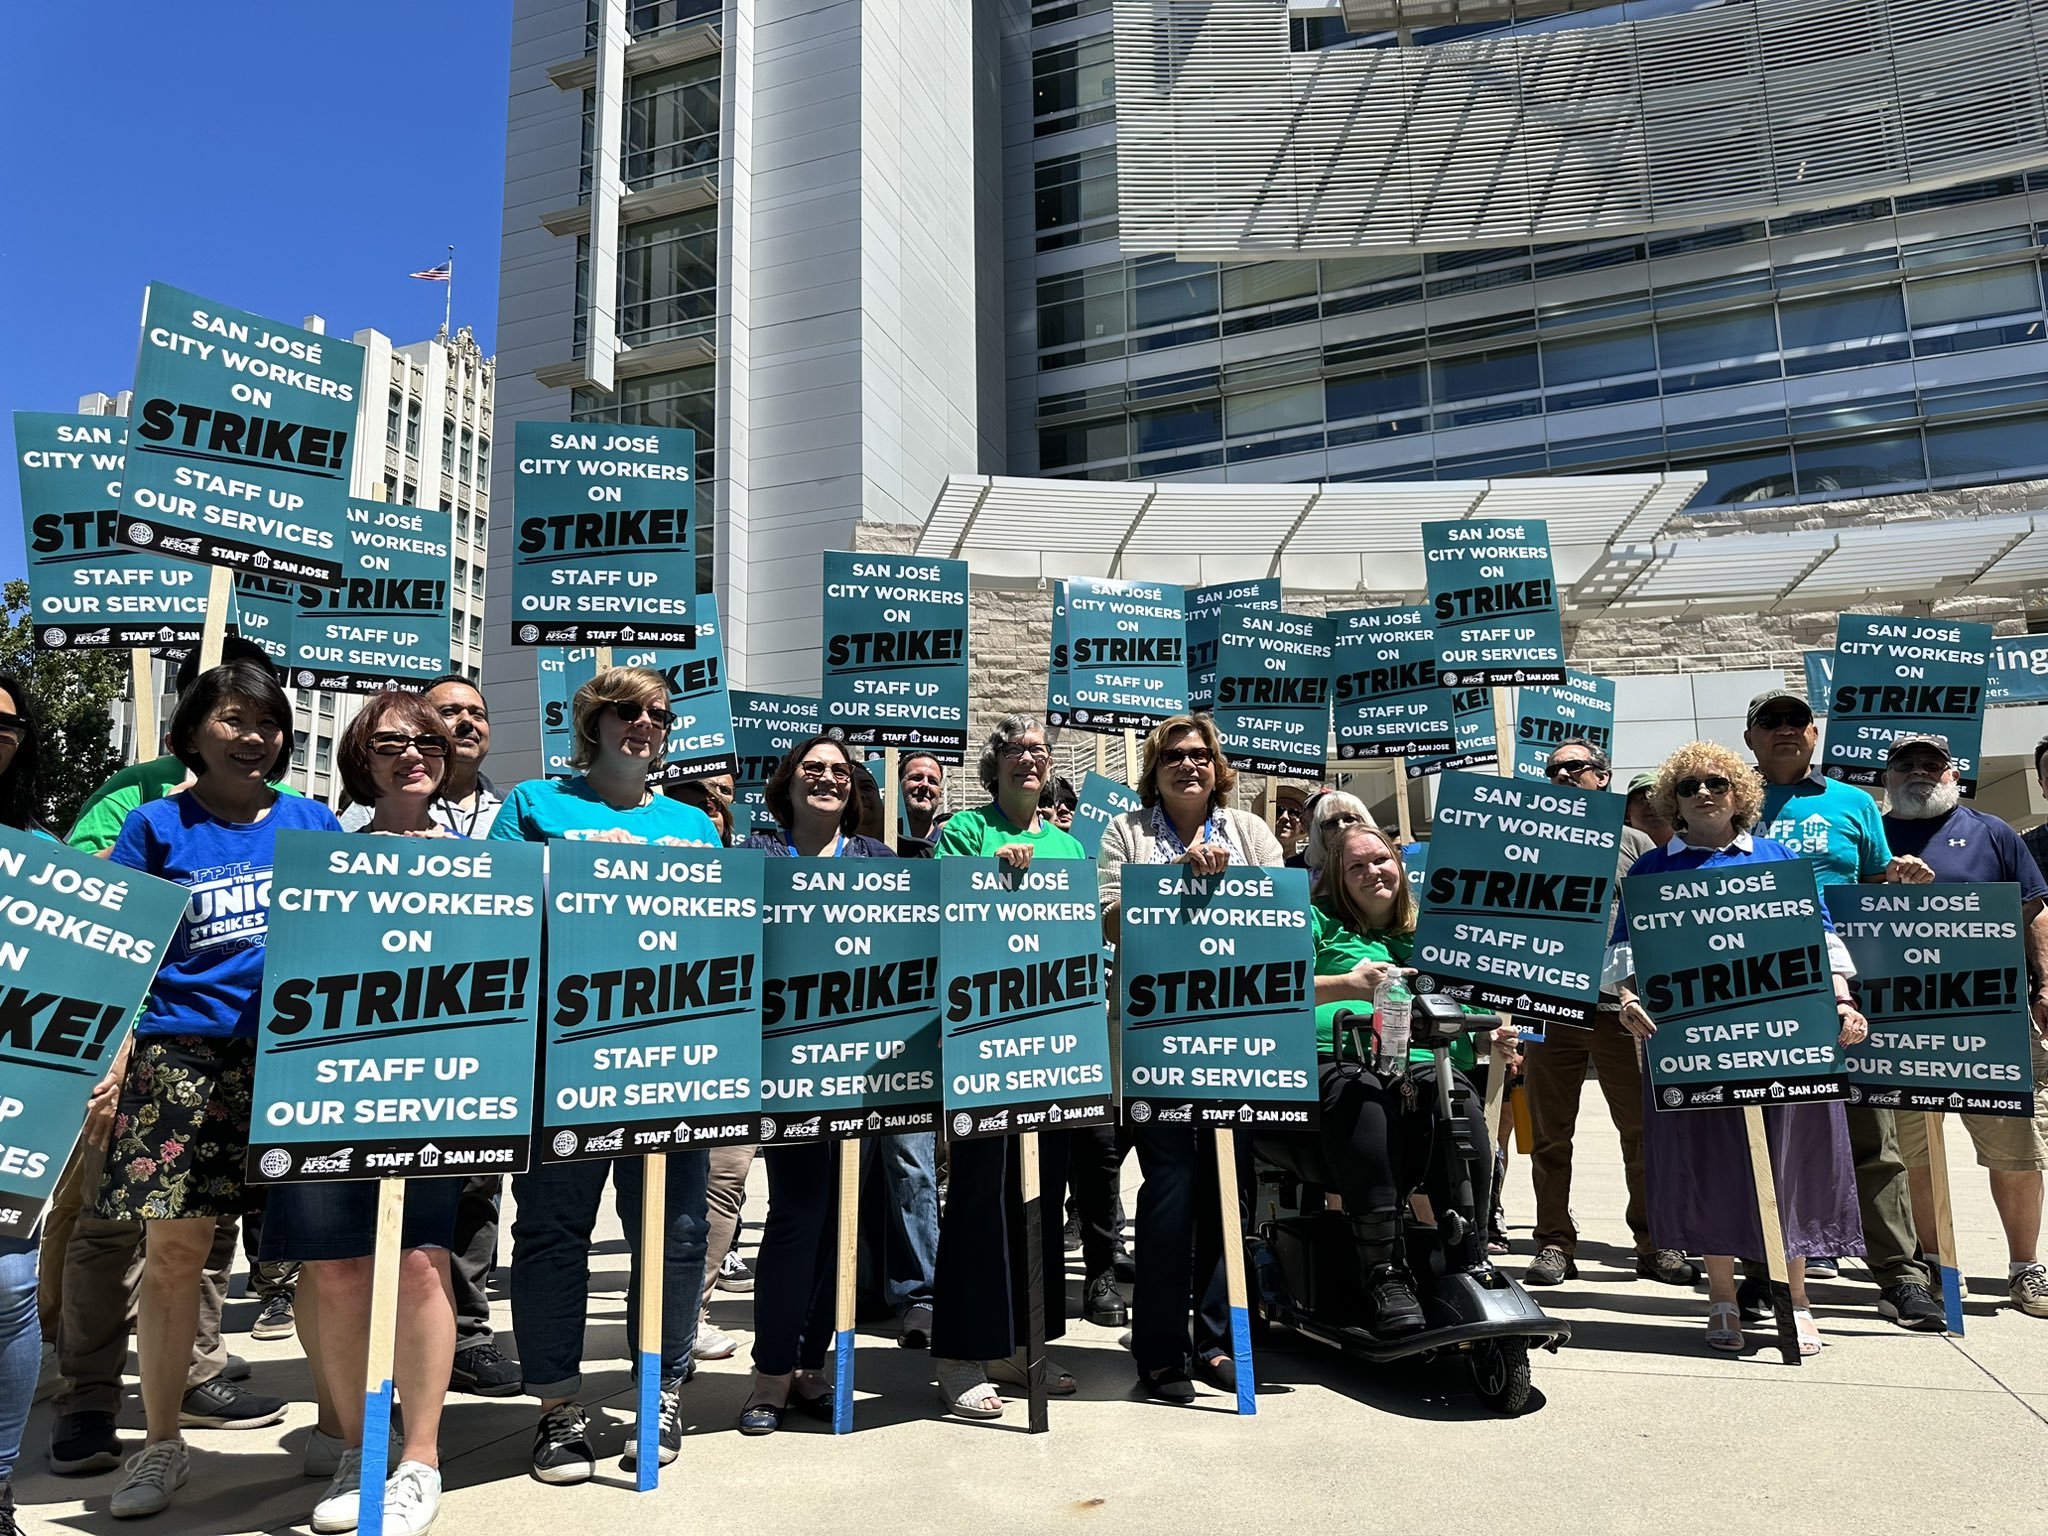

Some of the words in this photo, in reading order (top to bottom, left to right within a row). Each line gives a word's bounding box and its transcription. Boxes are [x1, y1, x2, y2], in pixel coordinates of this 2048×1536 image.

[191, 310, 249, 343] SAN
[254, 331, 322, 365] JOSÉ
[150, 327, 215, 361] CITY
[221, 348, 353, 402] WORKERS
[231, 383, 272, 409] ON
[138, 398, 347, 469] STRIKE!
[550, 434, 596, 450] SAN
[602, 435, 659, 454] JOSÉ
[519, 458, 571, 475] CITY
[576, 460, 689, 482] WORKERS
[174, 466, 262, 501] STAFF
[268, 489, 304, 512] UP
[587, 485, 622, 502] ON
[134, 488, 197, 519] OUR
[202, 505, 334, 549] SERVICES
[373, 512, 423, 532] JOSÉ
[518, 508, 689, 553] STRIKE!
[1448, 527, 1483, 541] SAN
[1486, 525, 1526, 540] JOSÉ
[350, 530, 447, 557] WORKERS
[1427, 548, 1464, 562] CITY
[1469, 546, 1548, 559] WORKERS
[360, 554, 390, 571] ON
[852, 563, 891, 578] SAN
[895, 565, 941, 582] JOSÉ
[1479, 565, 1504, 578] ON
[551, 569, 622, 586] STAFF
[627, 571, 658, 587] UP
[521, 595, 571, 611] OUR
[577, 595, 687, 615] SERVICES
[827, 584, 870, 599] CITY
[874, 586, 964, 605] WORKERS
[1434, 579, 1552, 620] STRIKE!
[883, 608, 911, 623] ON
[1072, 598, 1106, 612] CITY
[1109, 601, 1182, 620] WORKERS
[326, 624, 388, 643] STAFF
[393, 631, 419, 644] UP
[1116, 620, 1139, 633] ON
[1242, 616, 1273, 632] SAN
[1275, 621, 1313, 637] JOSÉ
[1460, 628, 1511, 642] STAFF
[1514, 628, 1536, 641] UP
[1867, 624, 1907, 638] SAN
[1911, 627, 1961, 643] JOSÉ
[299, 645, 344, 663] OUR
[348, 649, 443, 669] SERVICES
[826, 628, 963, 665] STRIKE!
[1073, 638, 1182, 662] STRIKE!
[1221, 633, 1256, 648] CITY
[1258, 637, 1331, 658] WORKERS
[1441, 649, 1478, 663] OUR
[1481, 647, 1558, 661] SERVICES
[1839, 641, 1883, 656] CITY
[1888, 644, 1985, 665] WORKERS
[1264, 657, 1286, 671] ON
[1895, 665, 1924, 679] ON
[853, 680, 911, 695] STAFF
[915, 682, 940, 697] UP
[1095, 673, 1141, 688] STAFF
[1144, 678, 1164, 691] UP
[1217, 677, 1328, 703] STRIKE!
[829, 701, 870, 716] OUR
[874, 703, 961, 721] SERVICES
[1076, 690, 1109, 703] OUR
[1112, 692, 1183, 710] SERVICES
[1832, 685, 1981, 714] STRIKE!
[1236, 716, 1282, 732] STAFF
[1284, 721, 1305, 735] UP
[1218, 733, 1249, 748] OUR
[1251, 737, 1321, 756] SERVICES
[1831, 744, 1873, 760] OUR
[1473, 786, 1522, 808] SAN
[1526, 794, 1587, 818] JOSÉ
[1439, 807, 1493, 829] CITY
[1497, 815, 1615, 849] WORKERS
[328, 850, 399, 875] SAN
[407, 851, 492, 879] JOSÉ
[1504, 844, 1540, 864] ON
[233, 874, 255, 884] THE
[593, 858, 648, 881] SAN
[655, 859, 722, 883] JOSÉ
[971, 871, 1013, 890] SAN
[1018, 868, 1070, 891] JOSÉ
[1158, 878, 1207, 896] SAN
[1213, 876, 1274, 897] JOSÉ
[1425, 868, 1608, 914] STRIKE!
[1659, 881, 1710, 901] SAN
[1715, 870, 1777, 896] JOSÉ
[278, 887, 359, 913] CITY
[367, 891, 534, 917] WORKERS
[555, 891, 619, 914] CITY
[625, 894, 757, 918] WORKERS
[945, 903, 991, 922] CITY
[995, 902, 1097, 922] WORKERS
[1126, 907, 1181, 925] CITY
[1188, 908, 1306, 928] WORKERS
[1632, 910, 1685, 931] CITY
[1690, 898, 1815, 925] WORKERS
[190, 912, 265, 941] STRIKES
[381, 930, 432, 953] ON
[638, 930, 677, 951] ON
[1007, 934, 1040, 953] ON
[1199, 937, 1235, 956] ON
[1453, 924, 1527, 950] STAFF
[1532, 937, 1564, 957] UP
[1708, 932, 1745, 951] ON
[1421, 945, 1471, 969] OUR
[1476, 955, 1590, 991] SERVICES
[1646, 944, 1822, 1013] STRIKE!
[266, 957, 530, 1036] STRIKE!
[553, 954, 755, 1027] STRIKE!
[946, 953, 1098, 1022] STRIKE!
[1126, 960, 1307, 1017] STRIKE!
[1685, 1022, 1760, 1044] STAFF
[1765, 1019, 1800, 1038] UP
[593, 1045, 677, 1070] STAFF
[683, 1044, 718, 1066] UP
[979, 1036, 1046, 1060] STAFF
[1050, 1034, 1077, 1054] UP
[1162, 1036, 1238, 1055] STAFF
[1244, 1037, 1276, 1056] UP
[315, 1058, 425, 1083] STAFF
[434, 1057, 480, 1081] UP
[1659, 1054, 1712, 1073] OUR
[1717, 1045, 1835, 1070] SERVICES
[953, 1072, 1001, 1095] OUR
[1005, 1064, 1103, 1091] SERVICES
[1131, 1066, 1185, 1086] OUR
[1191, 1067, 1308, 1089] SERVICES
[556, 1085, 617, 1110] OUR
[623, 1077, 751, 1106] SERVICES
[266, 1100, 345, 1126] OUR
[353, 1096, 518, 1124] SERVICES
[634, 1131, 671, 1145] STAFF
[693, 1127, 719, 1140] SAN
[719, 1125, 749, 1137] JOSE
[366, 1152, 415, 1168] STAFF
[444, 1150, 475, 1165] SAN
[476, 1149, 514, 1163] JOSE
